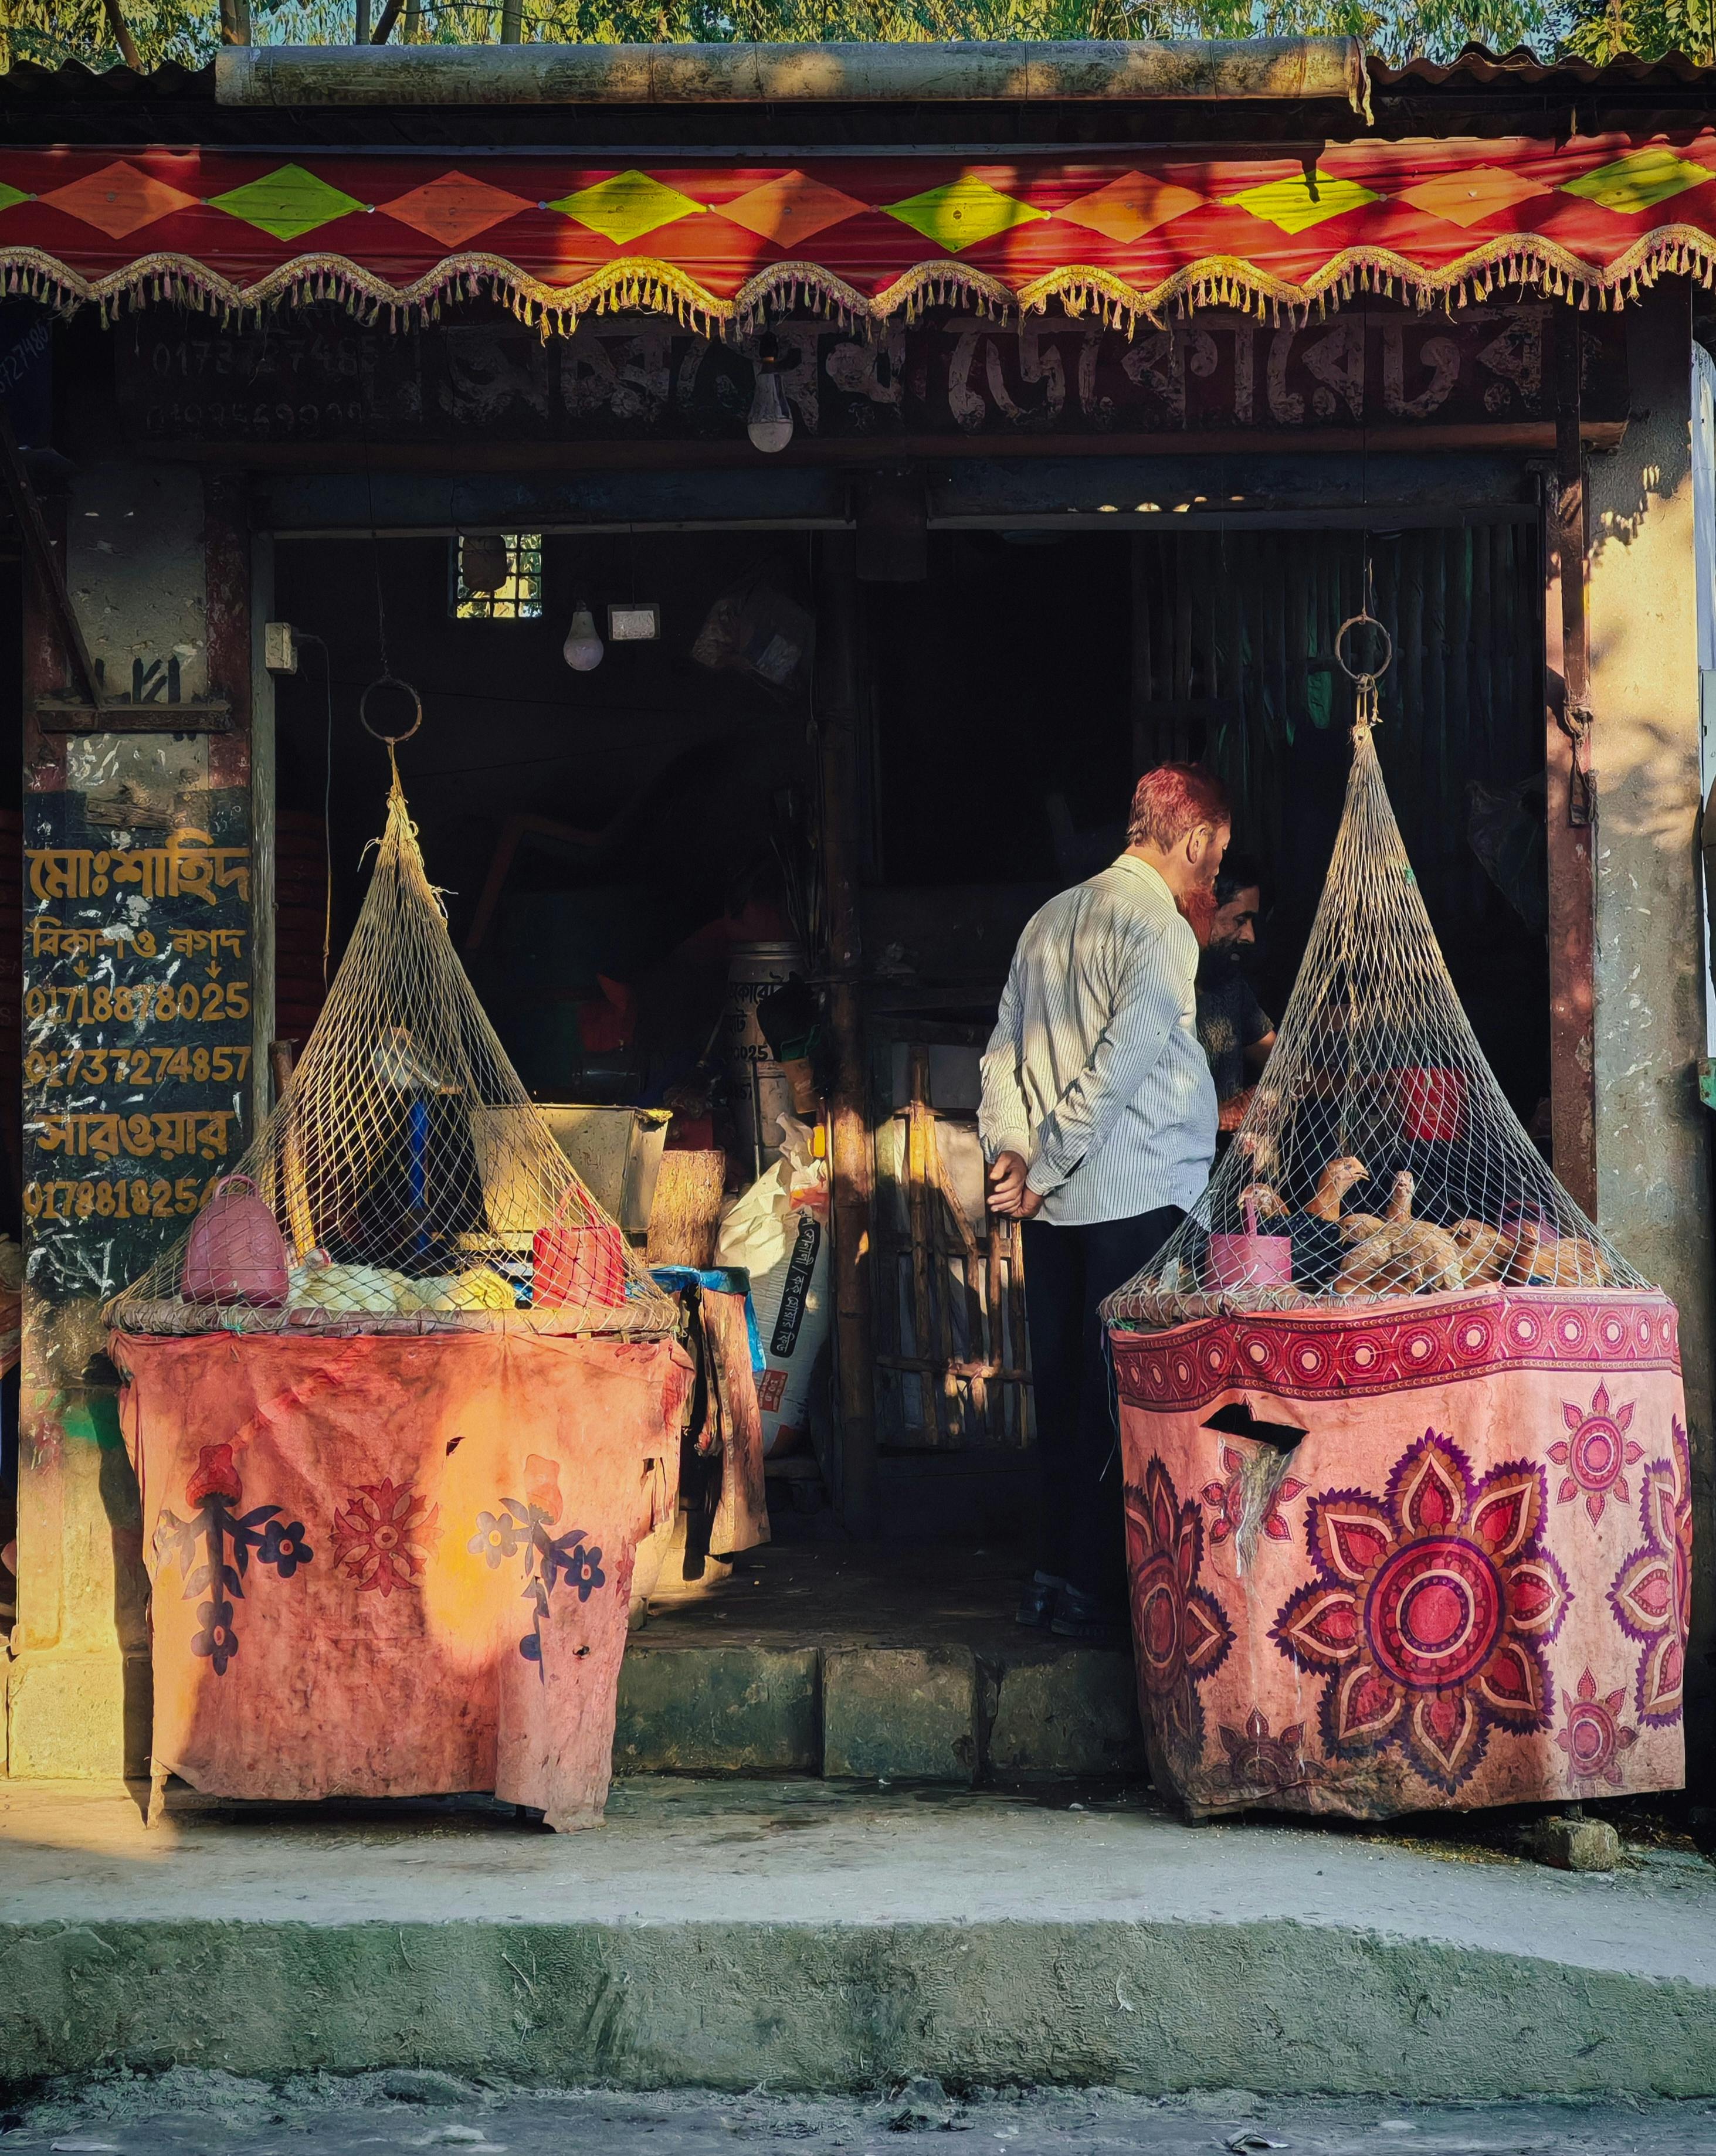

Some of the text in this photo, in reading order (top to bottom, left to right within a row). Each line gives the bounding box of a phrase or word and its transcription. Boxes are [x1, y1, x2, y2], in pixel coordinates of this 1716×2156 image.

[131, 929, 157, 958] ও
[168, 929, 247, 959] নগদ
[23, 1045, 252, 1088] 01737274857
[34, 1110, 236, 1162] সারওয়ার
[776, 1331, 795, 1353] ফিড
